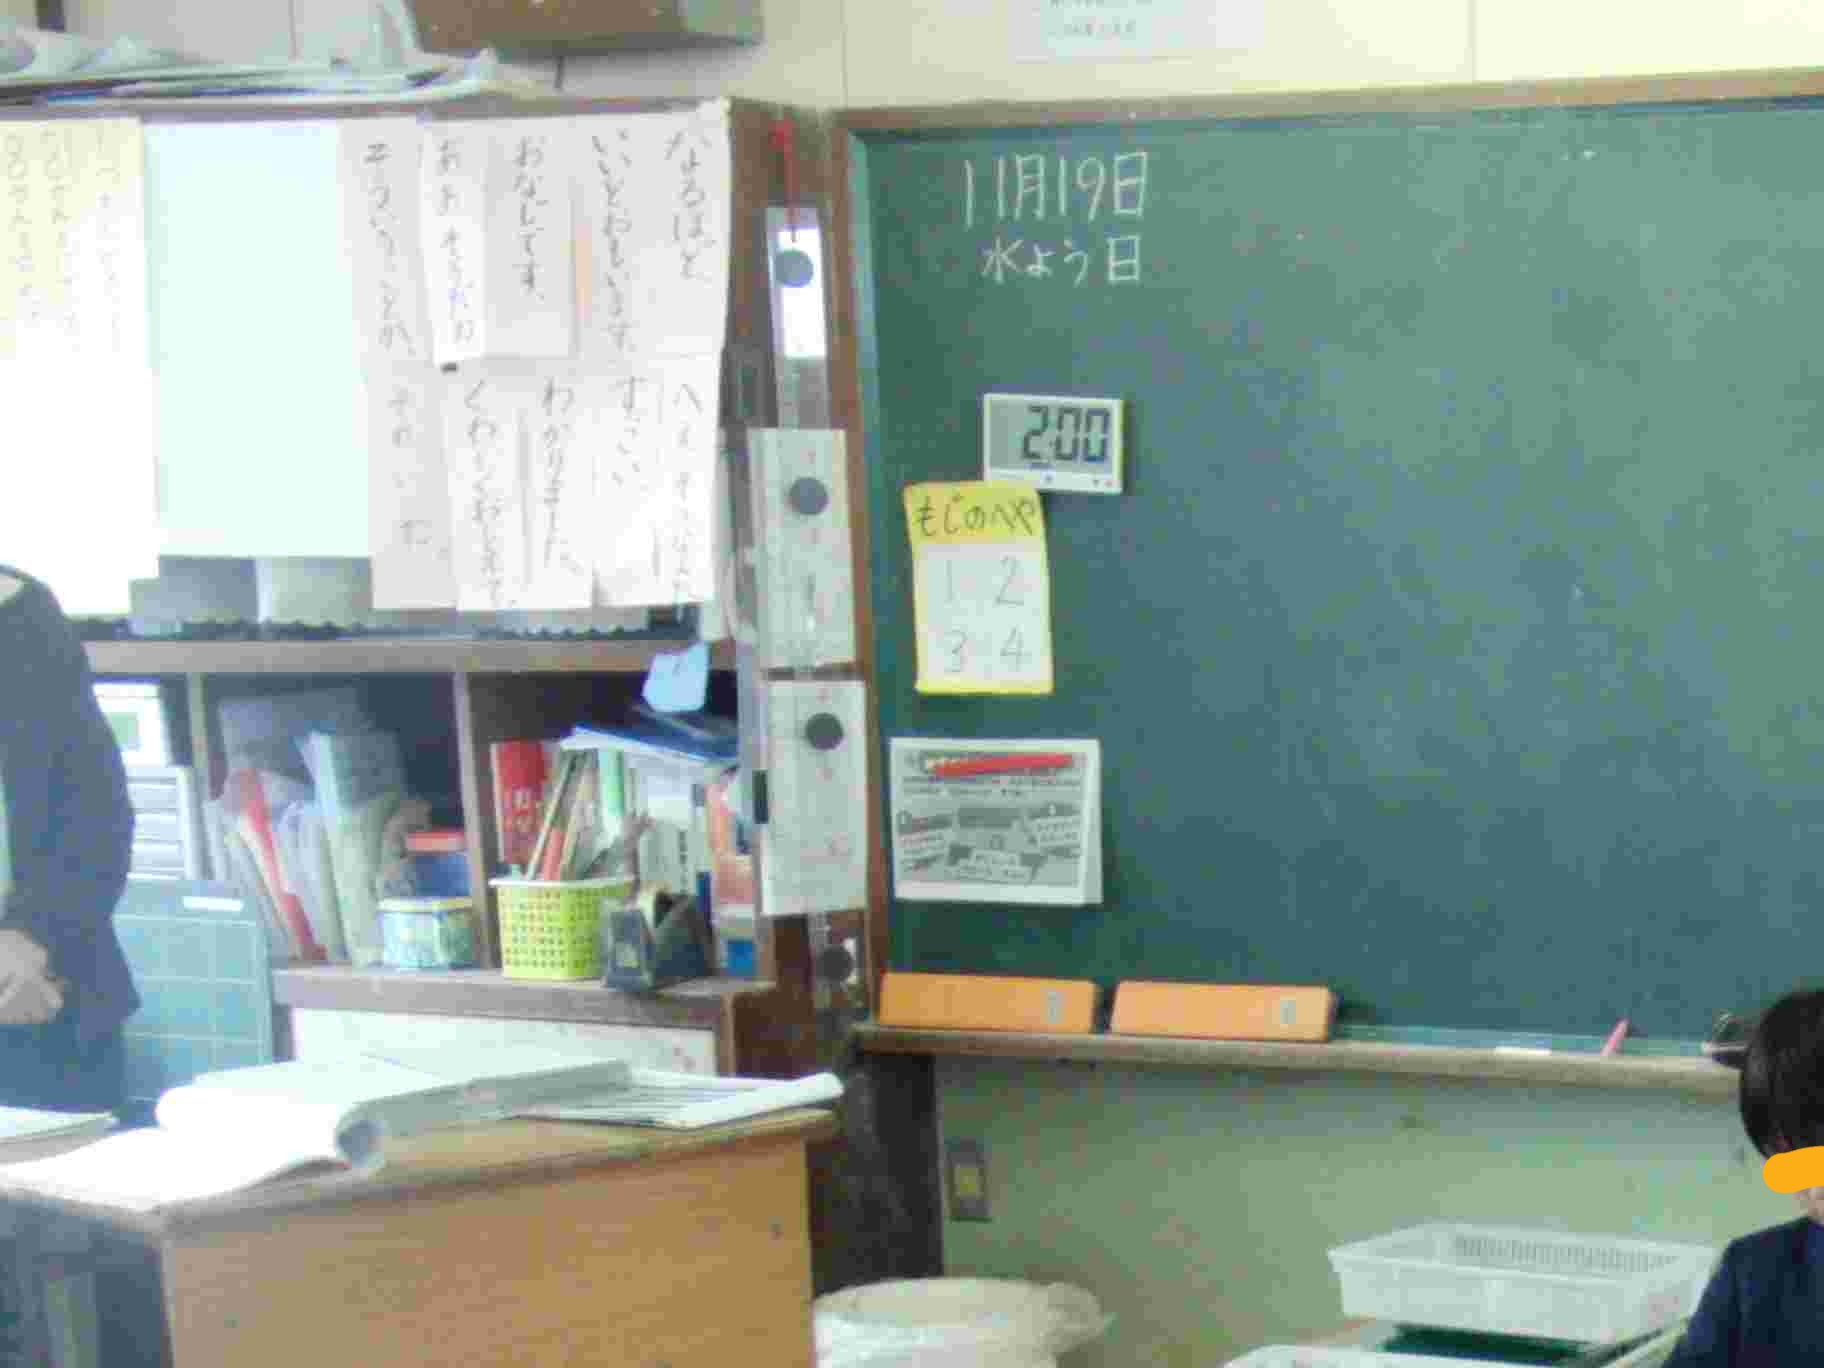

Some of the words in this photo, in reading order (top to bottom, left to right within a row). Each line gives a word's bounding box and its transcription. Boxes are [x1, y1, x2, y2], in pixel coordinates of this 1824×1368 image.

[961, 151, 1149, 231] 11月19日
[979, 235, 1143, 288] 水よう日
[1020, 404, 1111, 465] 2:00
[994, 553, 1026, 607] 2
[942, 629, 969, 674] 3
[999, 627, 1025, 674] 4
